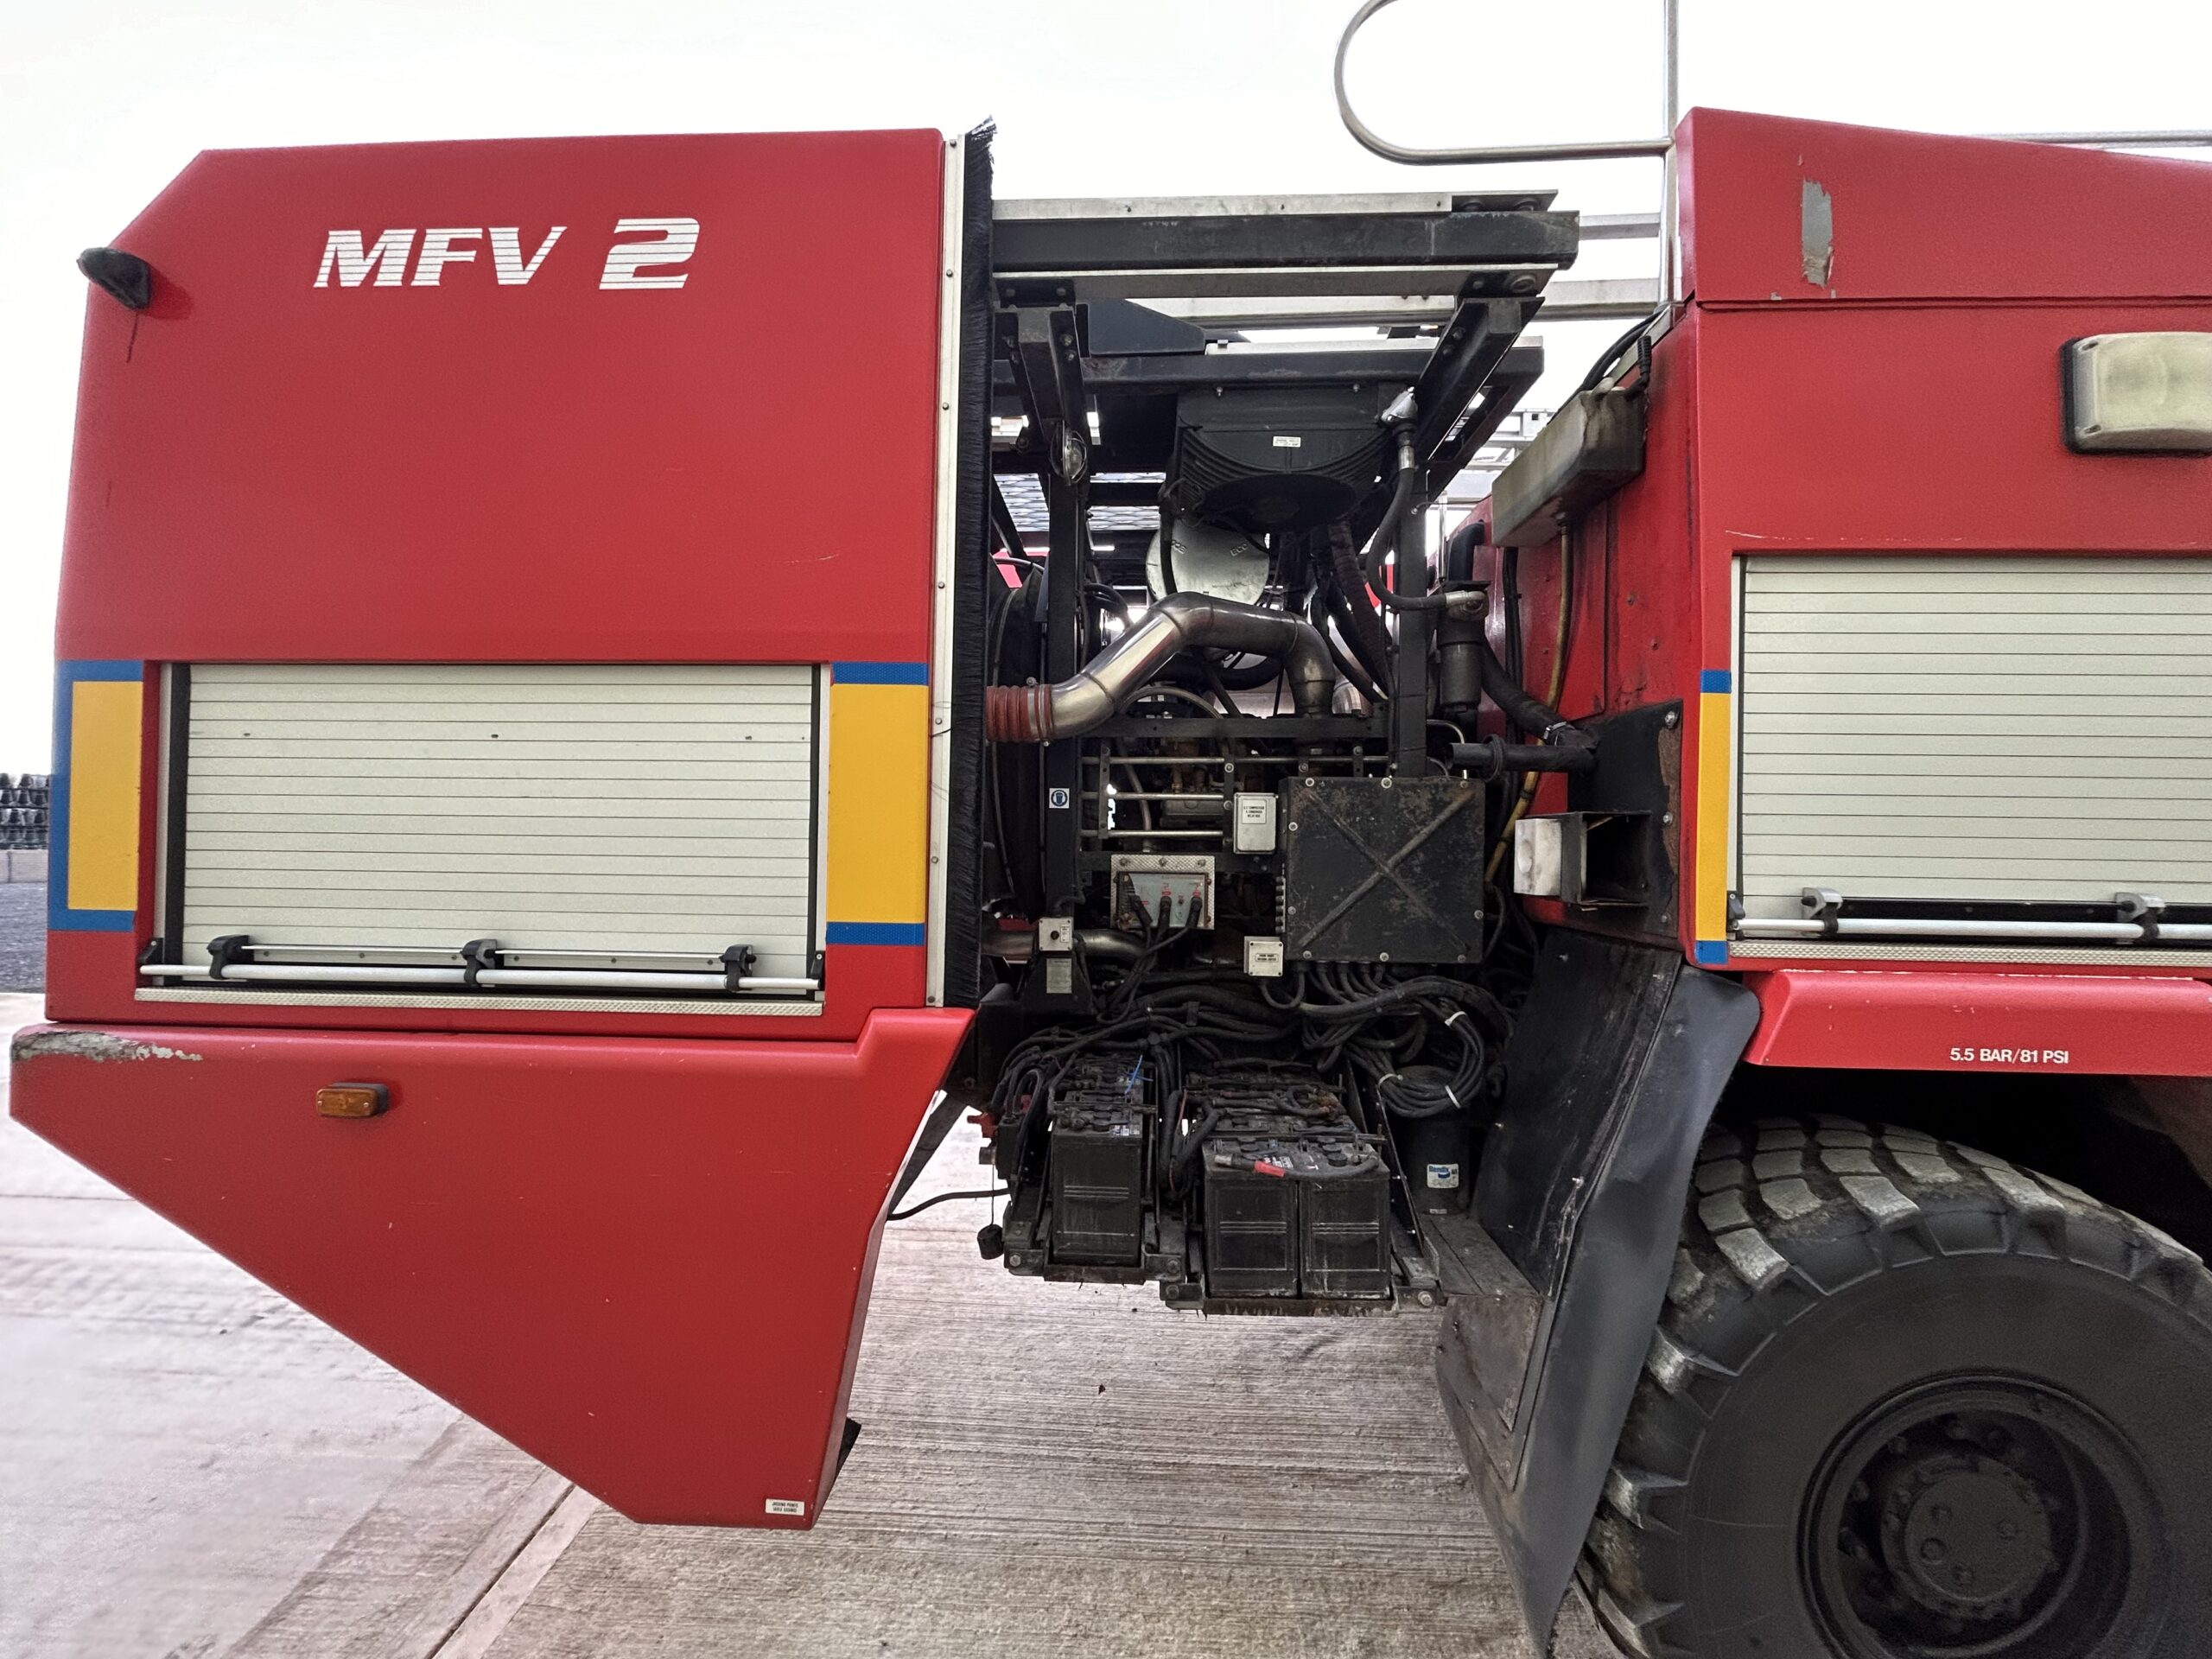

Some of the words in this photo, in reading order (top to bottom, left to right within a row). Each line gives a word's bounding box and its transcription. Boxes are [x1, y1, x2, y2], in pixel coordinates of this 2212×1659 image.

[314, 226, 567, 289] MFV
[599, 217, 701, 290] 2
[1949, 1047, 1974, 1062] 5.5
[1980, 1048, 2038, 1065] BAR/81
[2043, 1050, 2069, 1065] PSI
